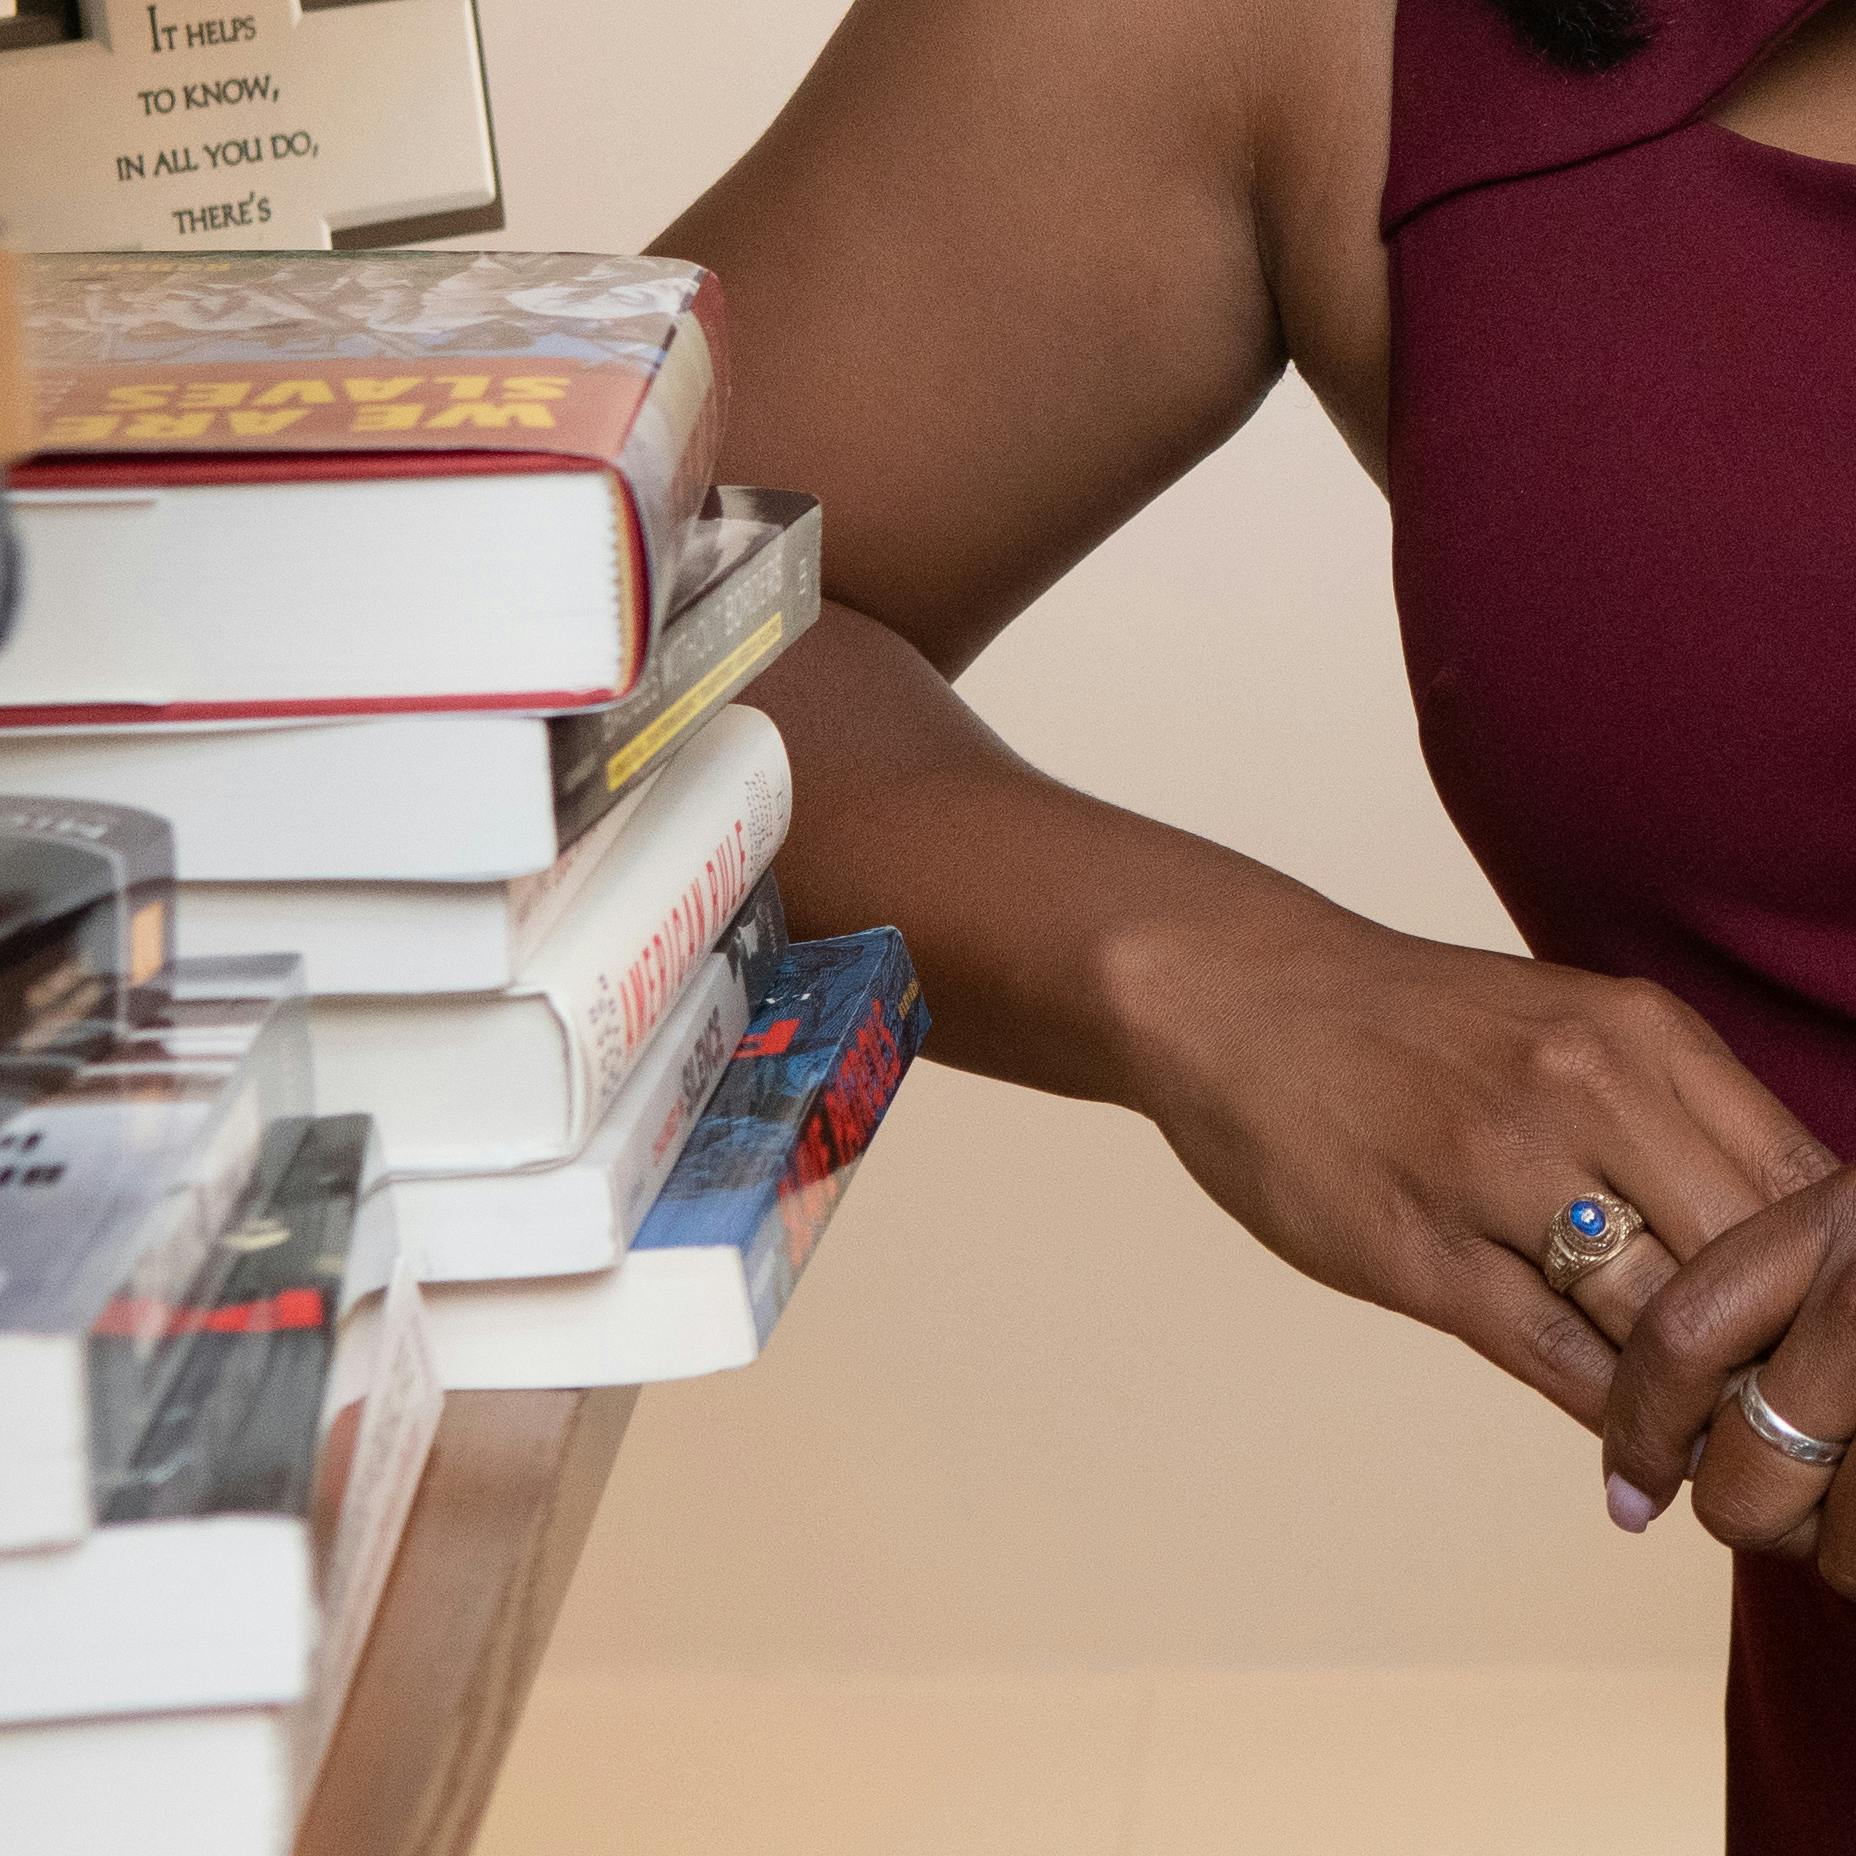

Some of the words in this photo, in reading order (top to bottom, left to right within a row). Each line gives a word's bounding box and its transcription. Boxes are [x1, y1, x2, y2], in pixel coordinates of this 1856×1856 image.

[186, 16, 258, 47] HELPS
[138, 87, 177, 117] TO
[183, 73, 281, 112] KNOW,
[116, 153, 146, 182] IN
[153, 145, 199, 177] ALL
[204, 137, 263, 170] YOU
[272, 129, 320, 160] DO,
[172, 191, 273, 235] THERE'S
[106, 374, 572, 414] SLAVES
[42, 406, 316, 444] ARE
[350, 402, 558, 433] WE
[619, 876, 706, 1060] AMERICAN
[705, 818, 747, 936] RULE
